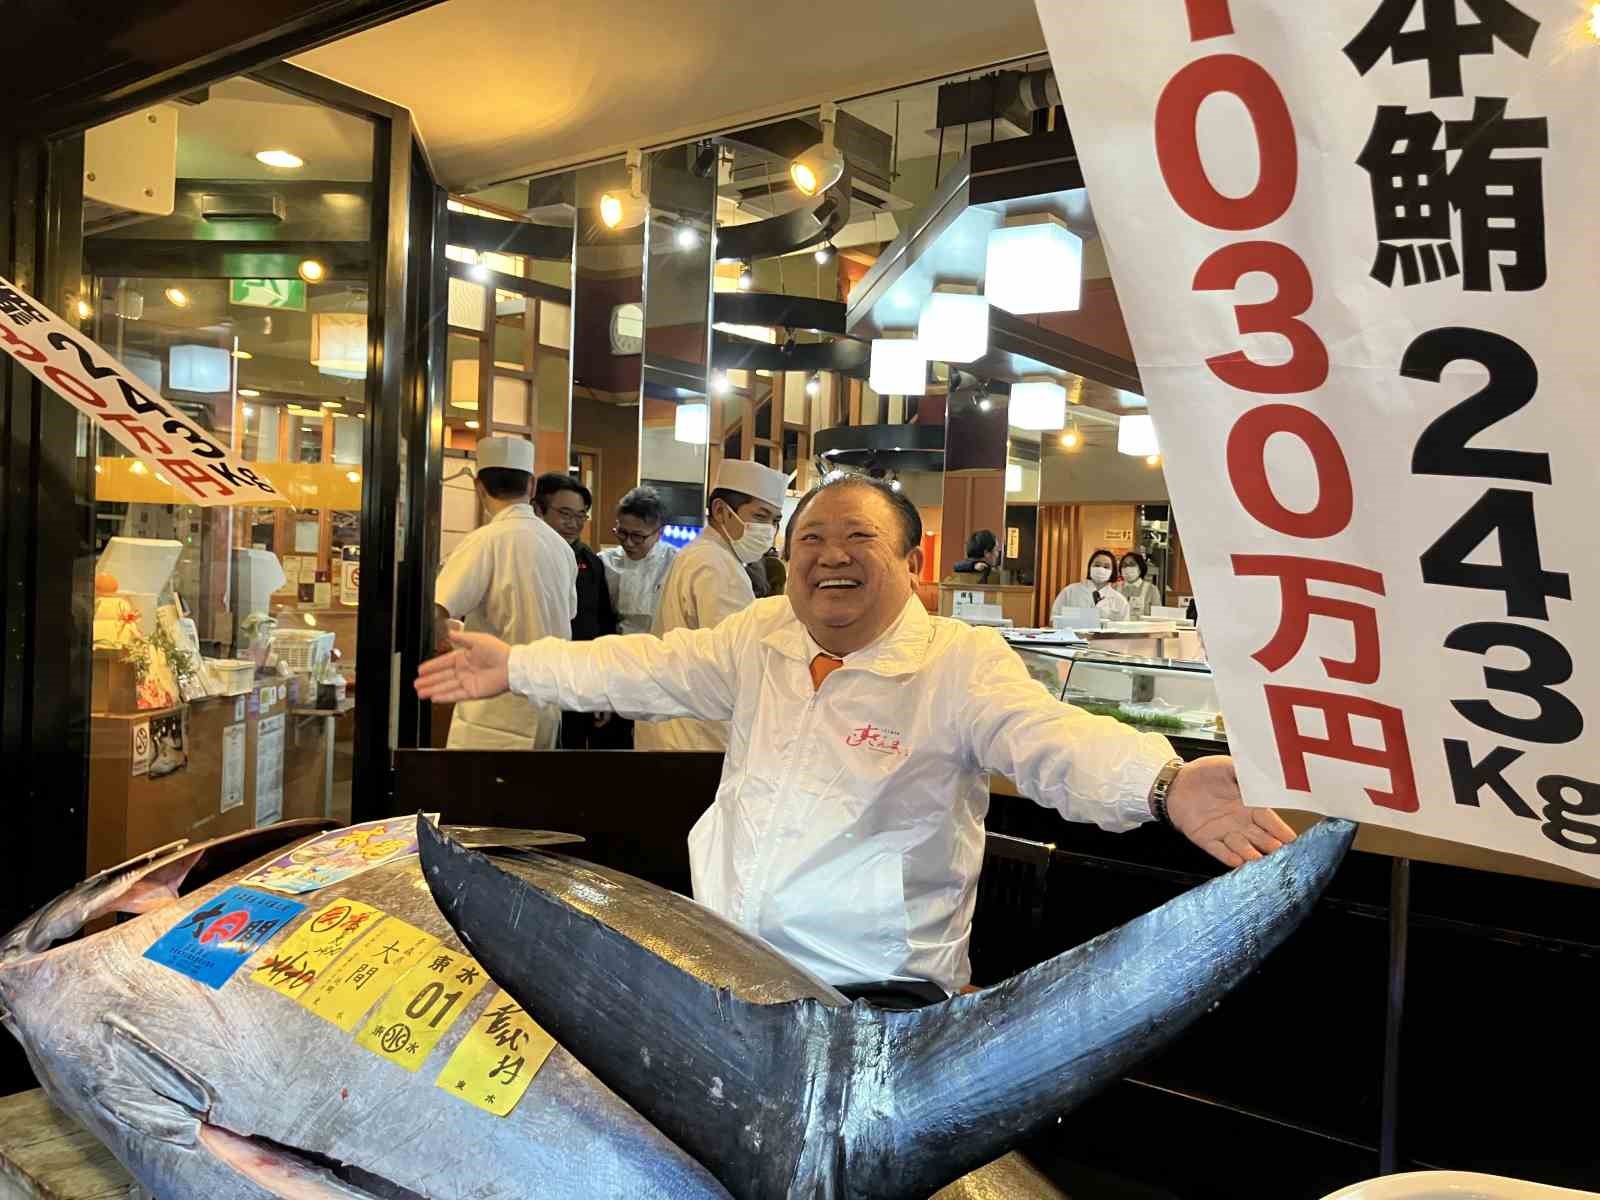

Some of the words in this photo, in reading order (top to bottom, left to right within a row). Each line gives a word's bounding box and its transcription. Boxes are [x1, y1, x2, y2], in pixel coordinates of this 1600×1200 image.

[1155, 0, 1420, 814] 030万円
[345, 940, 399, 990] 大間
[405, 982, 463, 1028] 01
